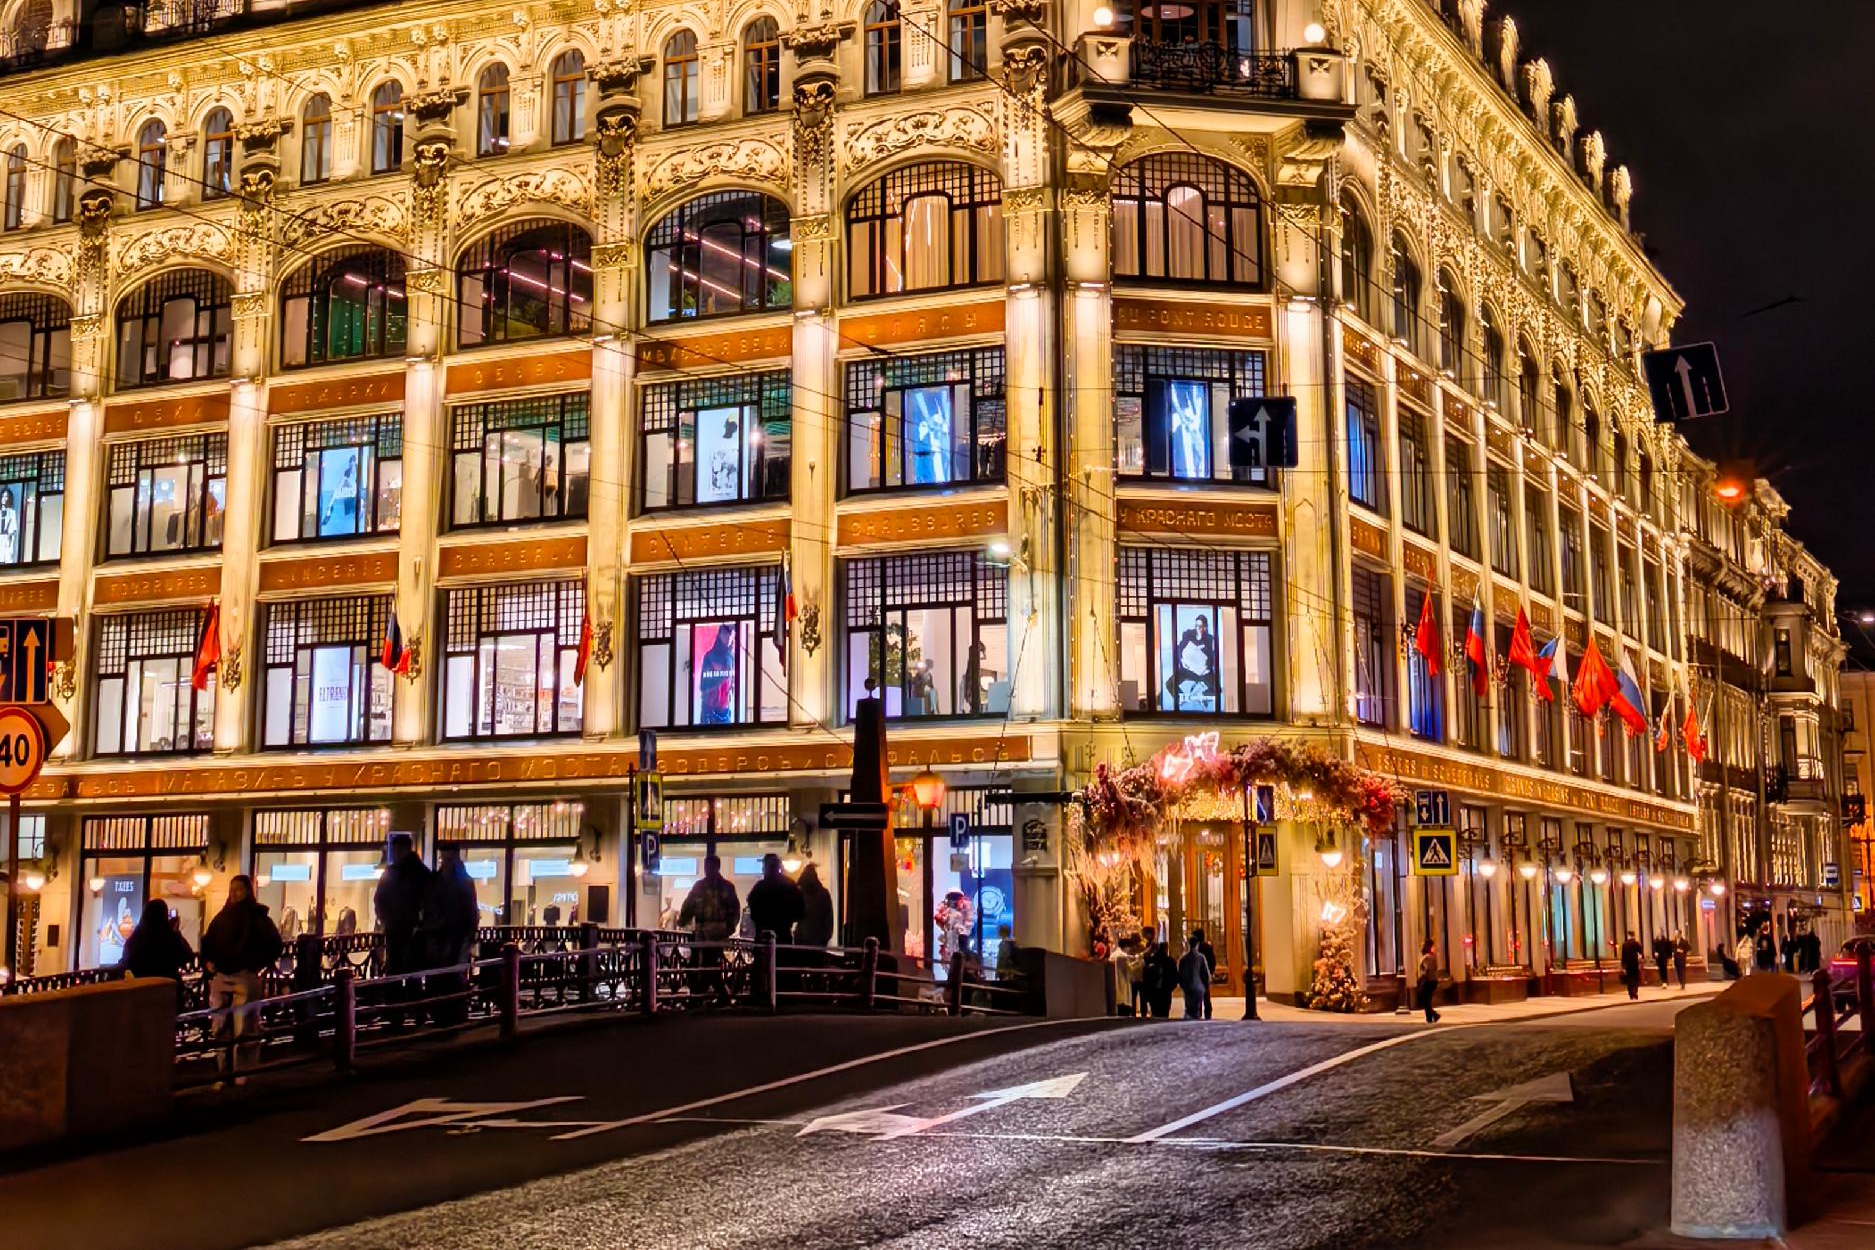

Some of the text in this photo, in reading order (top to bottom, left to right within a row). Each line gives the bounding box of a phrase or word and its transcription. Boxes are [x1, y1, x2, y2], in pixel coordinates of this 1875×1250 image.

[1149, 309, 1195, 327] PONT
[1204, 312, 1264, 329] ROUGE
[0, 734, 30, 768] 40
[954, 816, 967, 845] P
[647, 833, 657, 867] P
